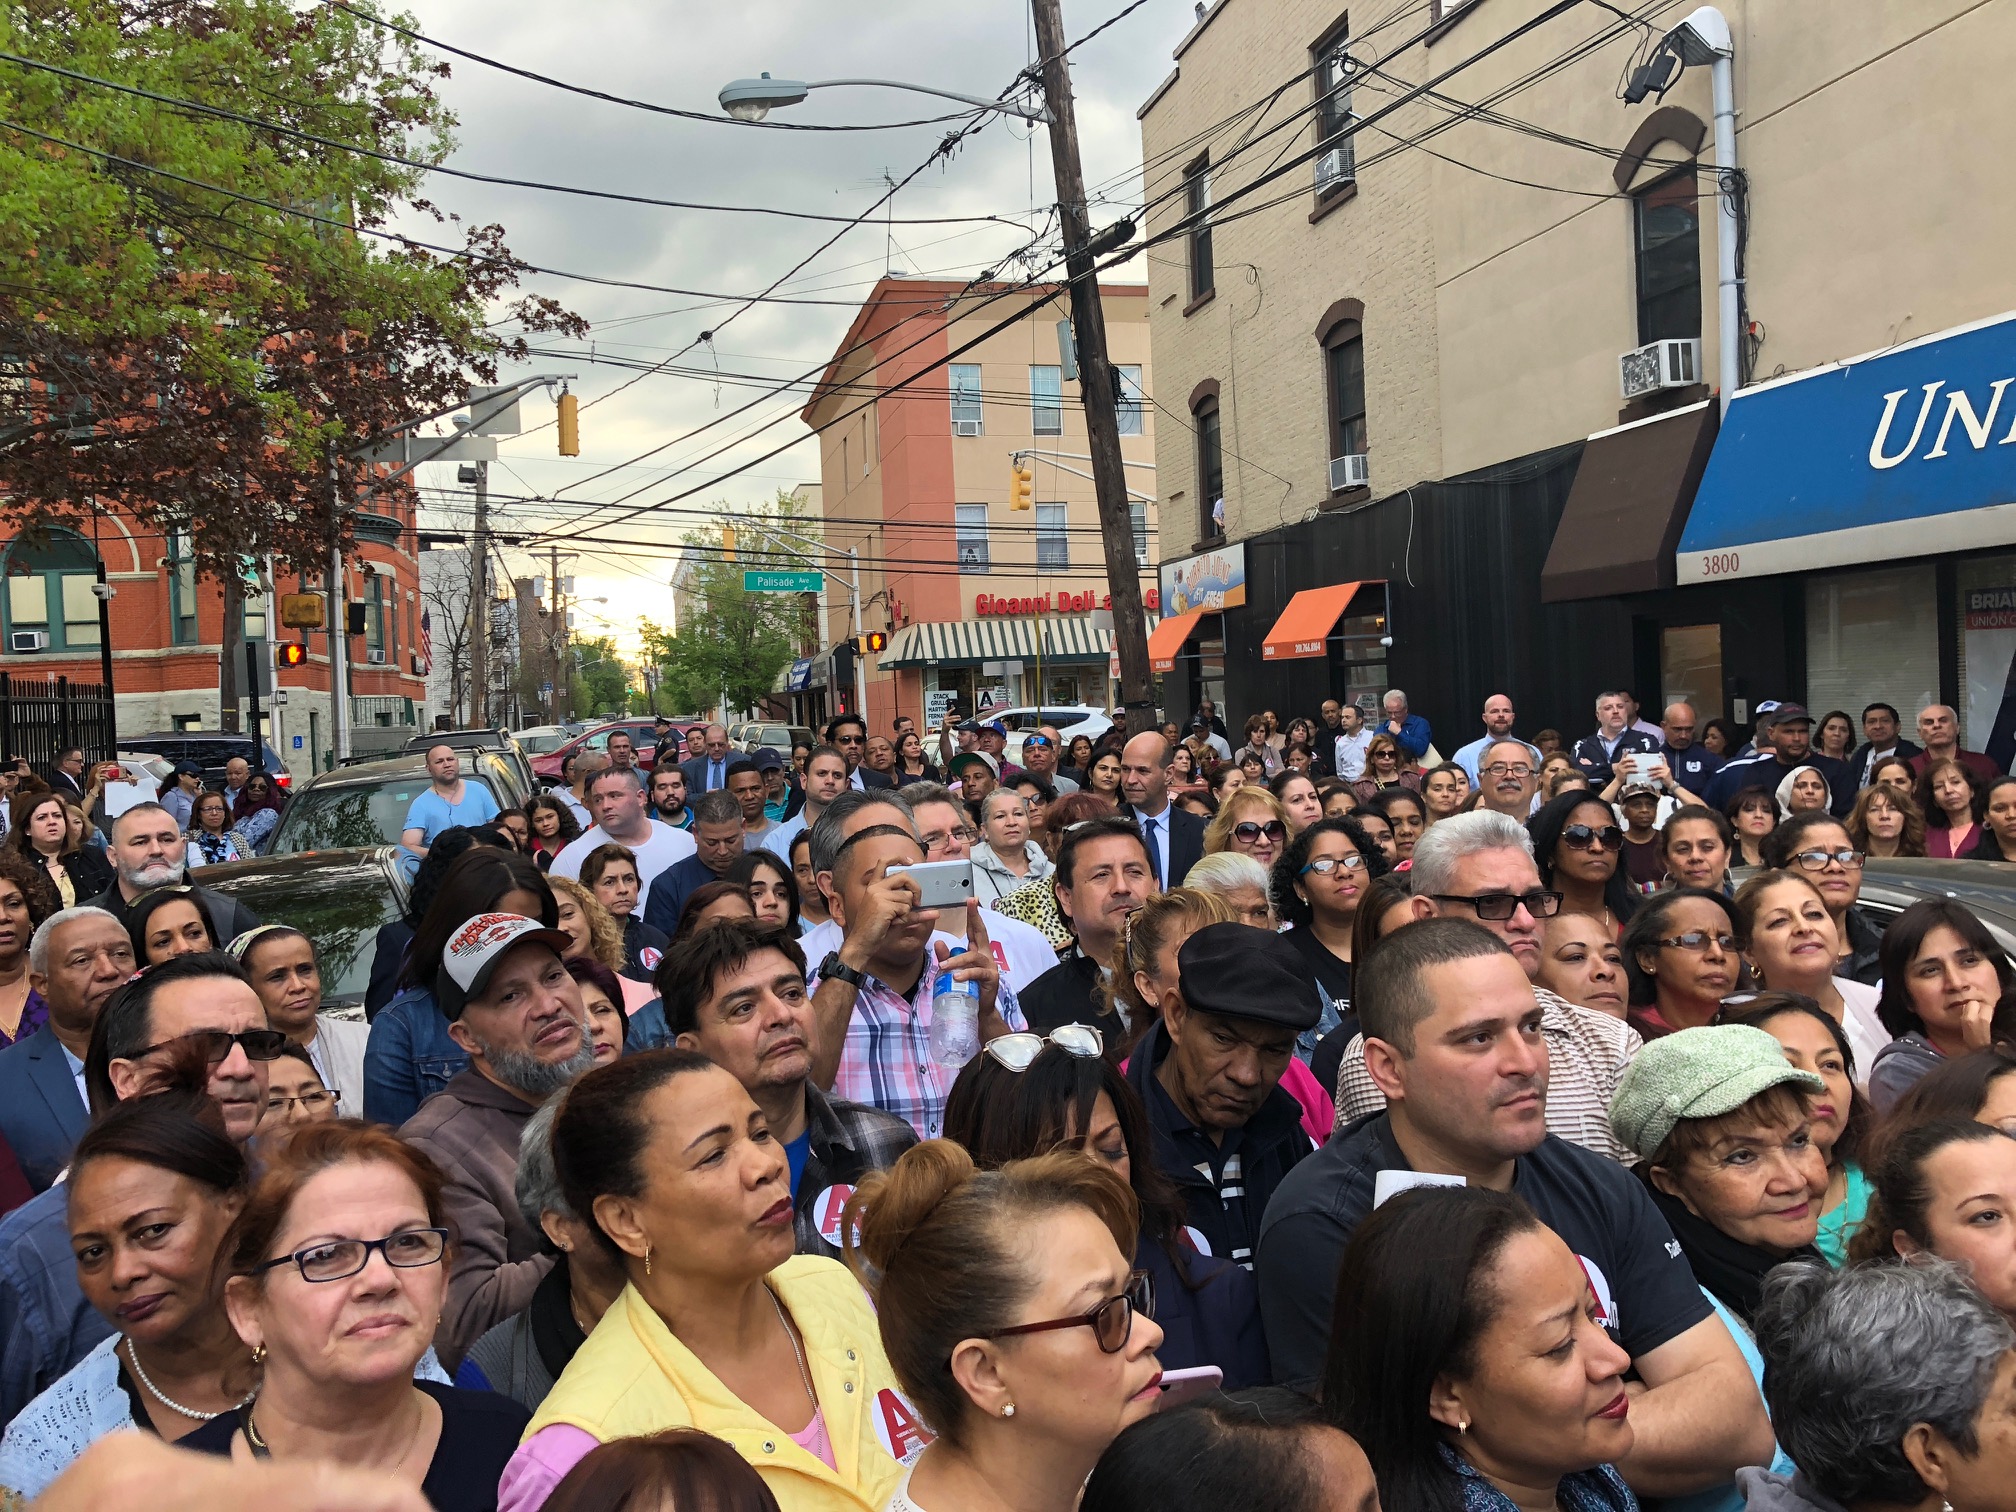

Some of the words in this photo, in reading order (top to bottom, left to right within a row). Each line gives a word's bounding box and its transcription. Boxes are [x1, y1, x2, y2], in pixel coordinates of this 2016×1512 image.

[1702, 552, 1740, 576] 3800
[757, 576, 794, 587] Palisade
[976, 592, 1051, 615] Gioanni
[1058, 590, 1096, 612] Deli
[1971, 615, 2007, 627] UNION
[877, 1388, 936, 1460] A
